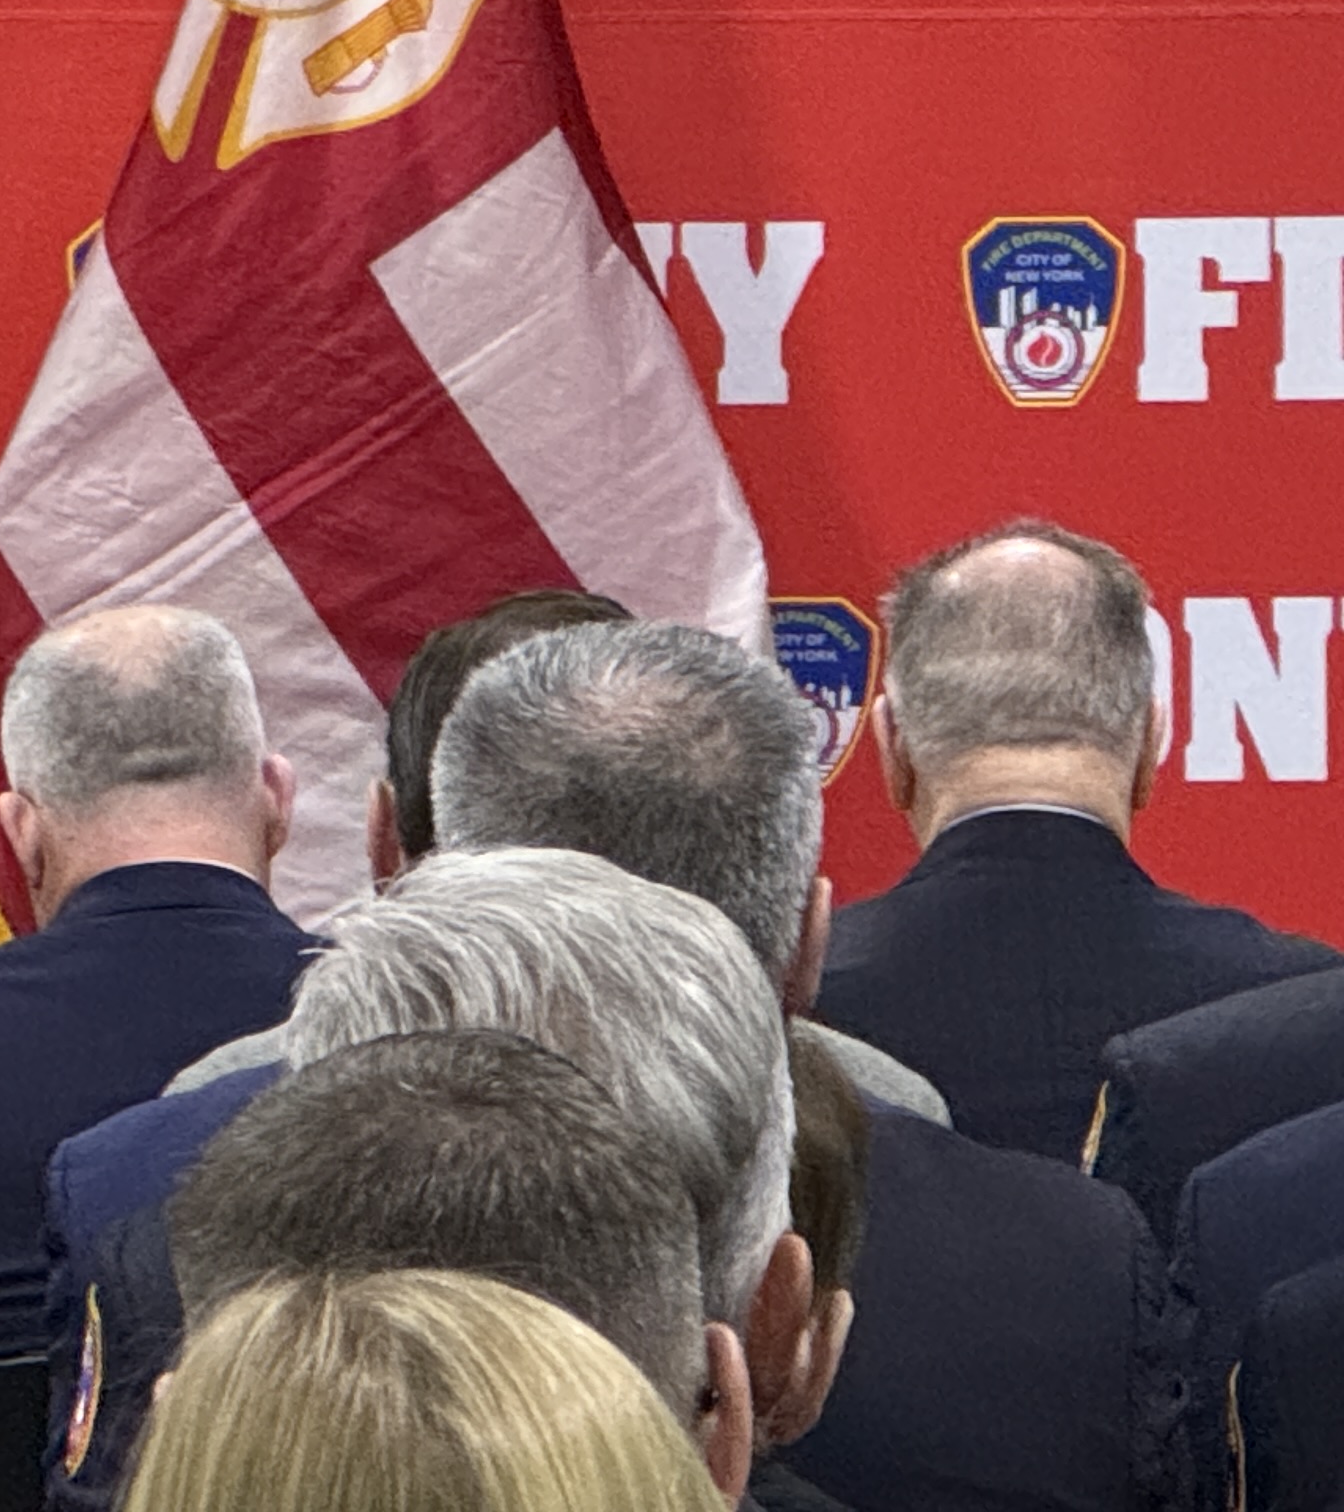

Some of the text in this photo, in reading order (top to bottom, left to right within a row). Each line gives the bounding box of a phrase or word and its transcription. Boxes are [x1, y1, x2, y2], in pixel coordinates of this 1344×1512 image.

[1016, 253, 1073, 266] CITY OF
[1005, 270, 1084, 283] NEW YORK
[805, 633, 828, 646] OF
[796, 649, 839, 663] YORK
